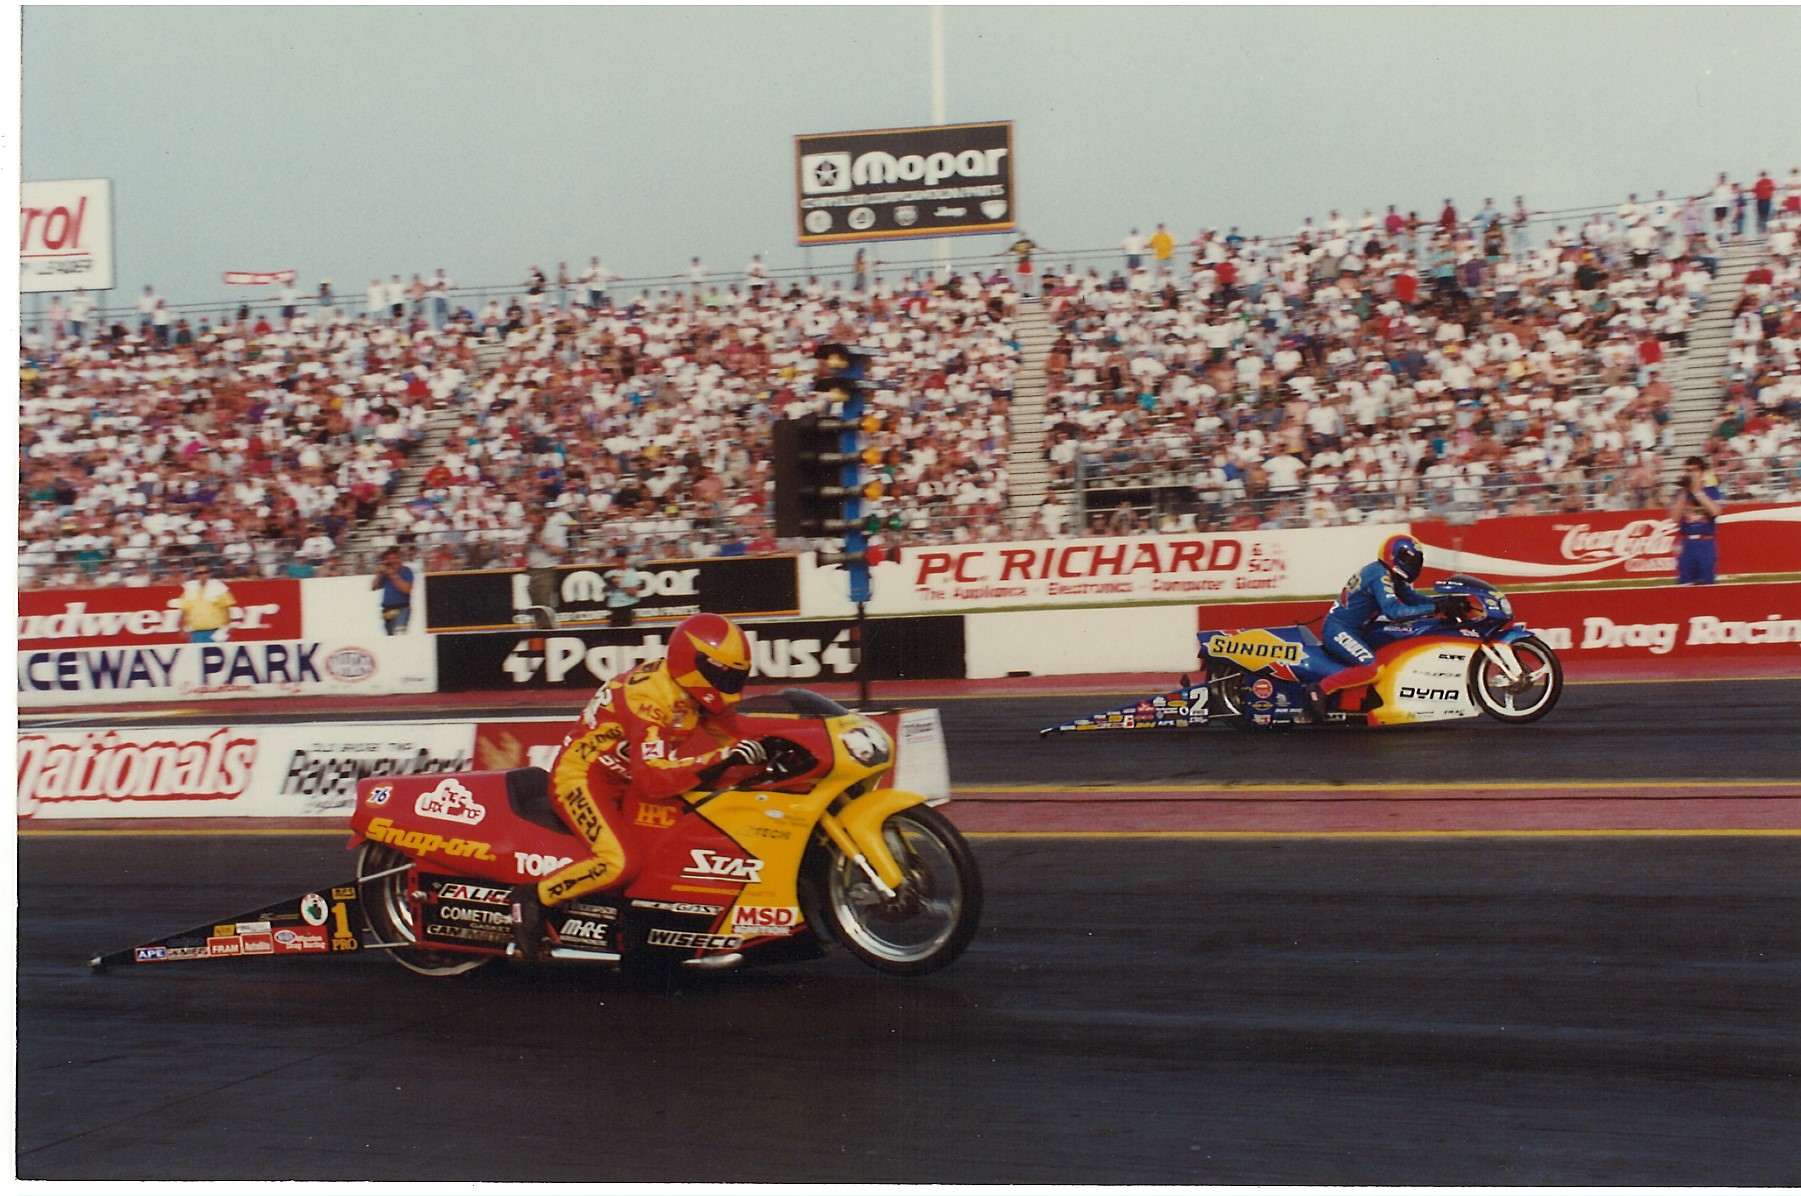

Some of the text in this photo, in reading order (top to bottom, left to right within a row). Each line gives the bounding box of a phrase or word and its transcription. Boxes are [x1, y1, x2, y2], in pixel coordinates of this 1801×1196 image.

[852, 148, 1008, 186] Mopar
[1552, 518, 1681, 560] Coca-Cola
[998, 539, 1243, 582] RICHARD
[561, 568, 701, 603] Mar
[1580, 616, 1679, 654] Drag
[1685, 613, 1801, 647] Racin
[545, 634, 668, 683] Part
[1212, 638, 1298, 662] SUNOCO
[18, 648, 181, 691] CEWAY
[201, 642, 321, 685] PARK
[1189, 686, 1209, 716] 2
[1399, 686, 1460, 700] DYNA
[366, 786, 393, 804] 76
[513, 851, 574, 876] TOR
[682, 848, 765, 883] STAR
[331, 901, 353, 938] 1
[736, 907, 793, 926] MSD
[138, 949, 165, 959] APE
[212, 944, 239, 954] FRAM
[332, 938, 358, 951] PRO
